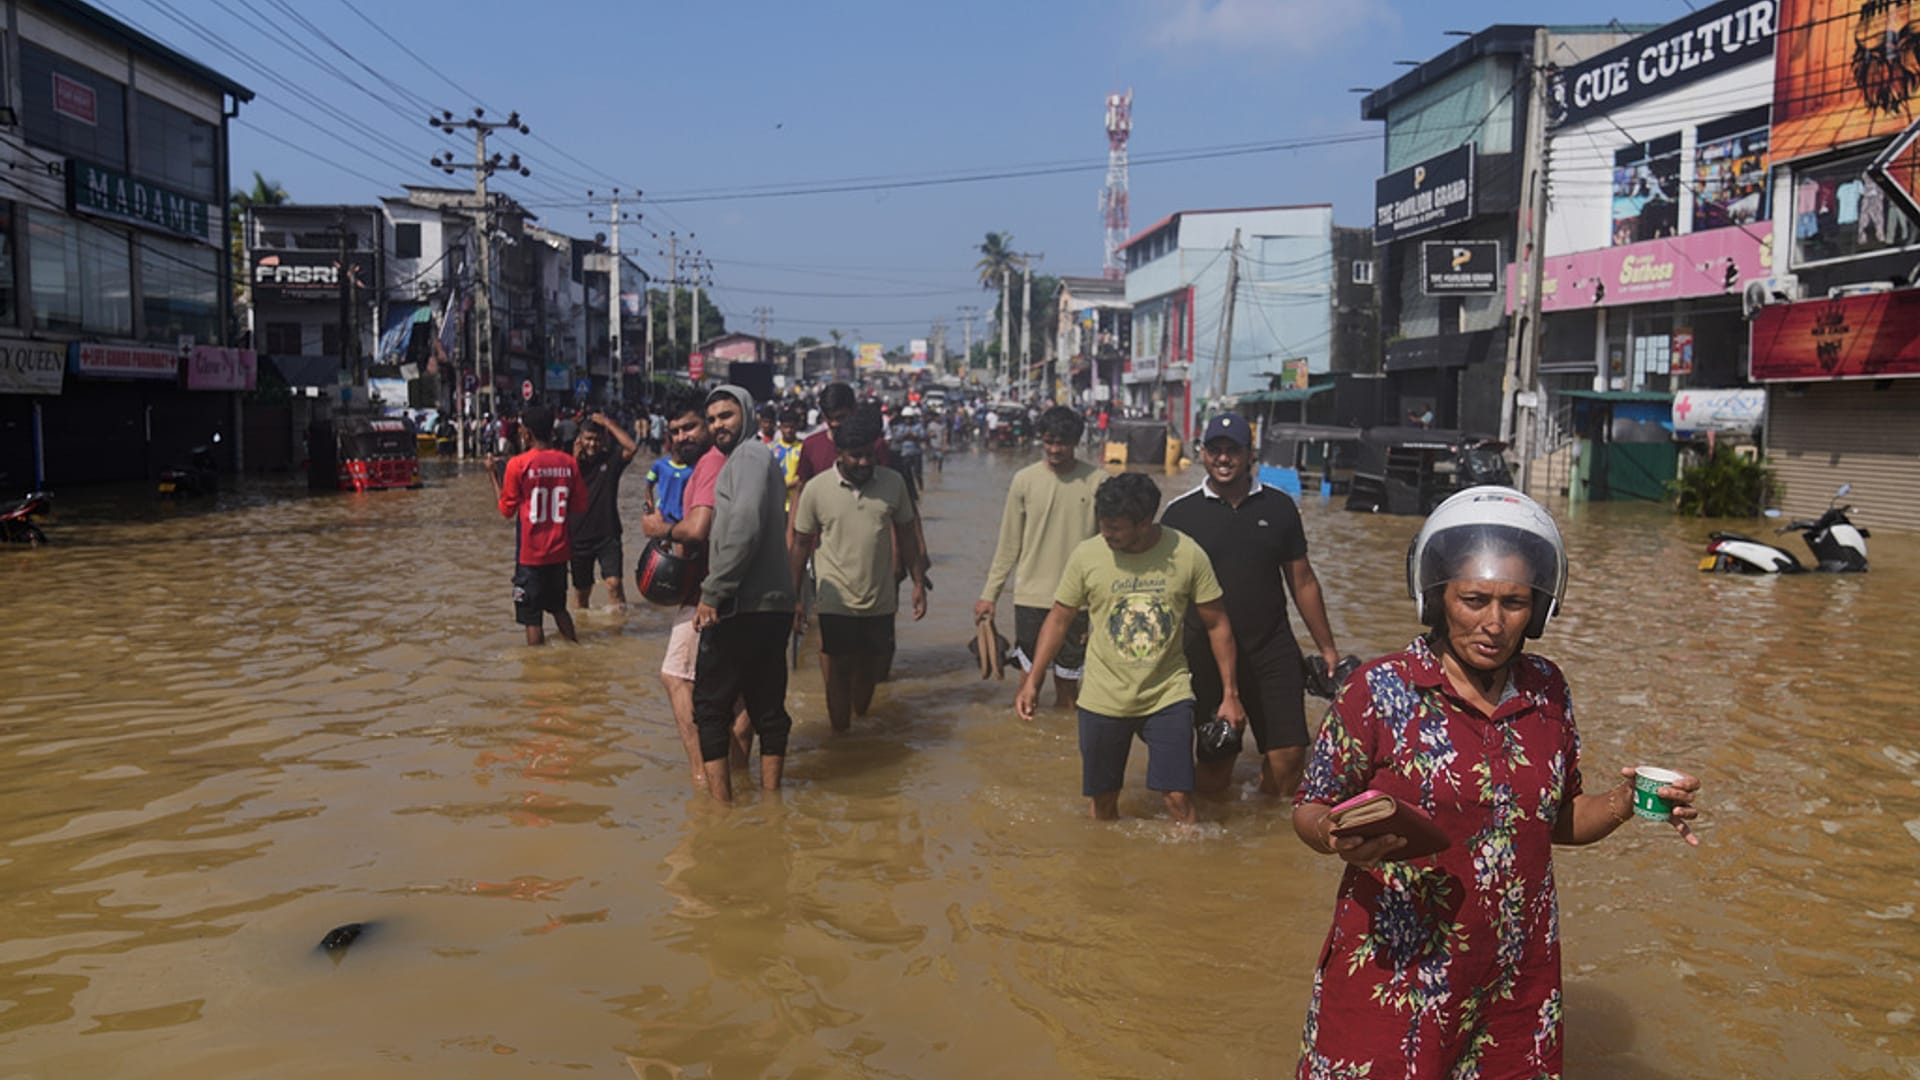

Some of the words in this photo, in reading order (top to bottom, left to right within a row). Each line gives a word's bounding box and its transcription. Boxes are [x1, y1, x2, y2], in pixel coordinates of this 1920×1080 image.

[1574, 57, 1630, 108] CUE
[87, 167, 201, 235] MADAME
[1378, 203, 1393, 227] THE
[1394, 190, 1433, 221] PAVILION
[1434, 179, 1467, 208] GRAND
[15, 348, 62, 374] QUEEN
[1111, 577, 1166, 593] California
